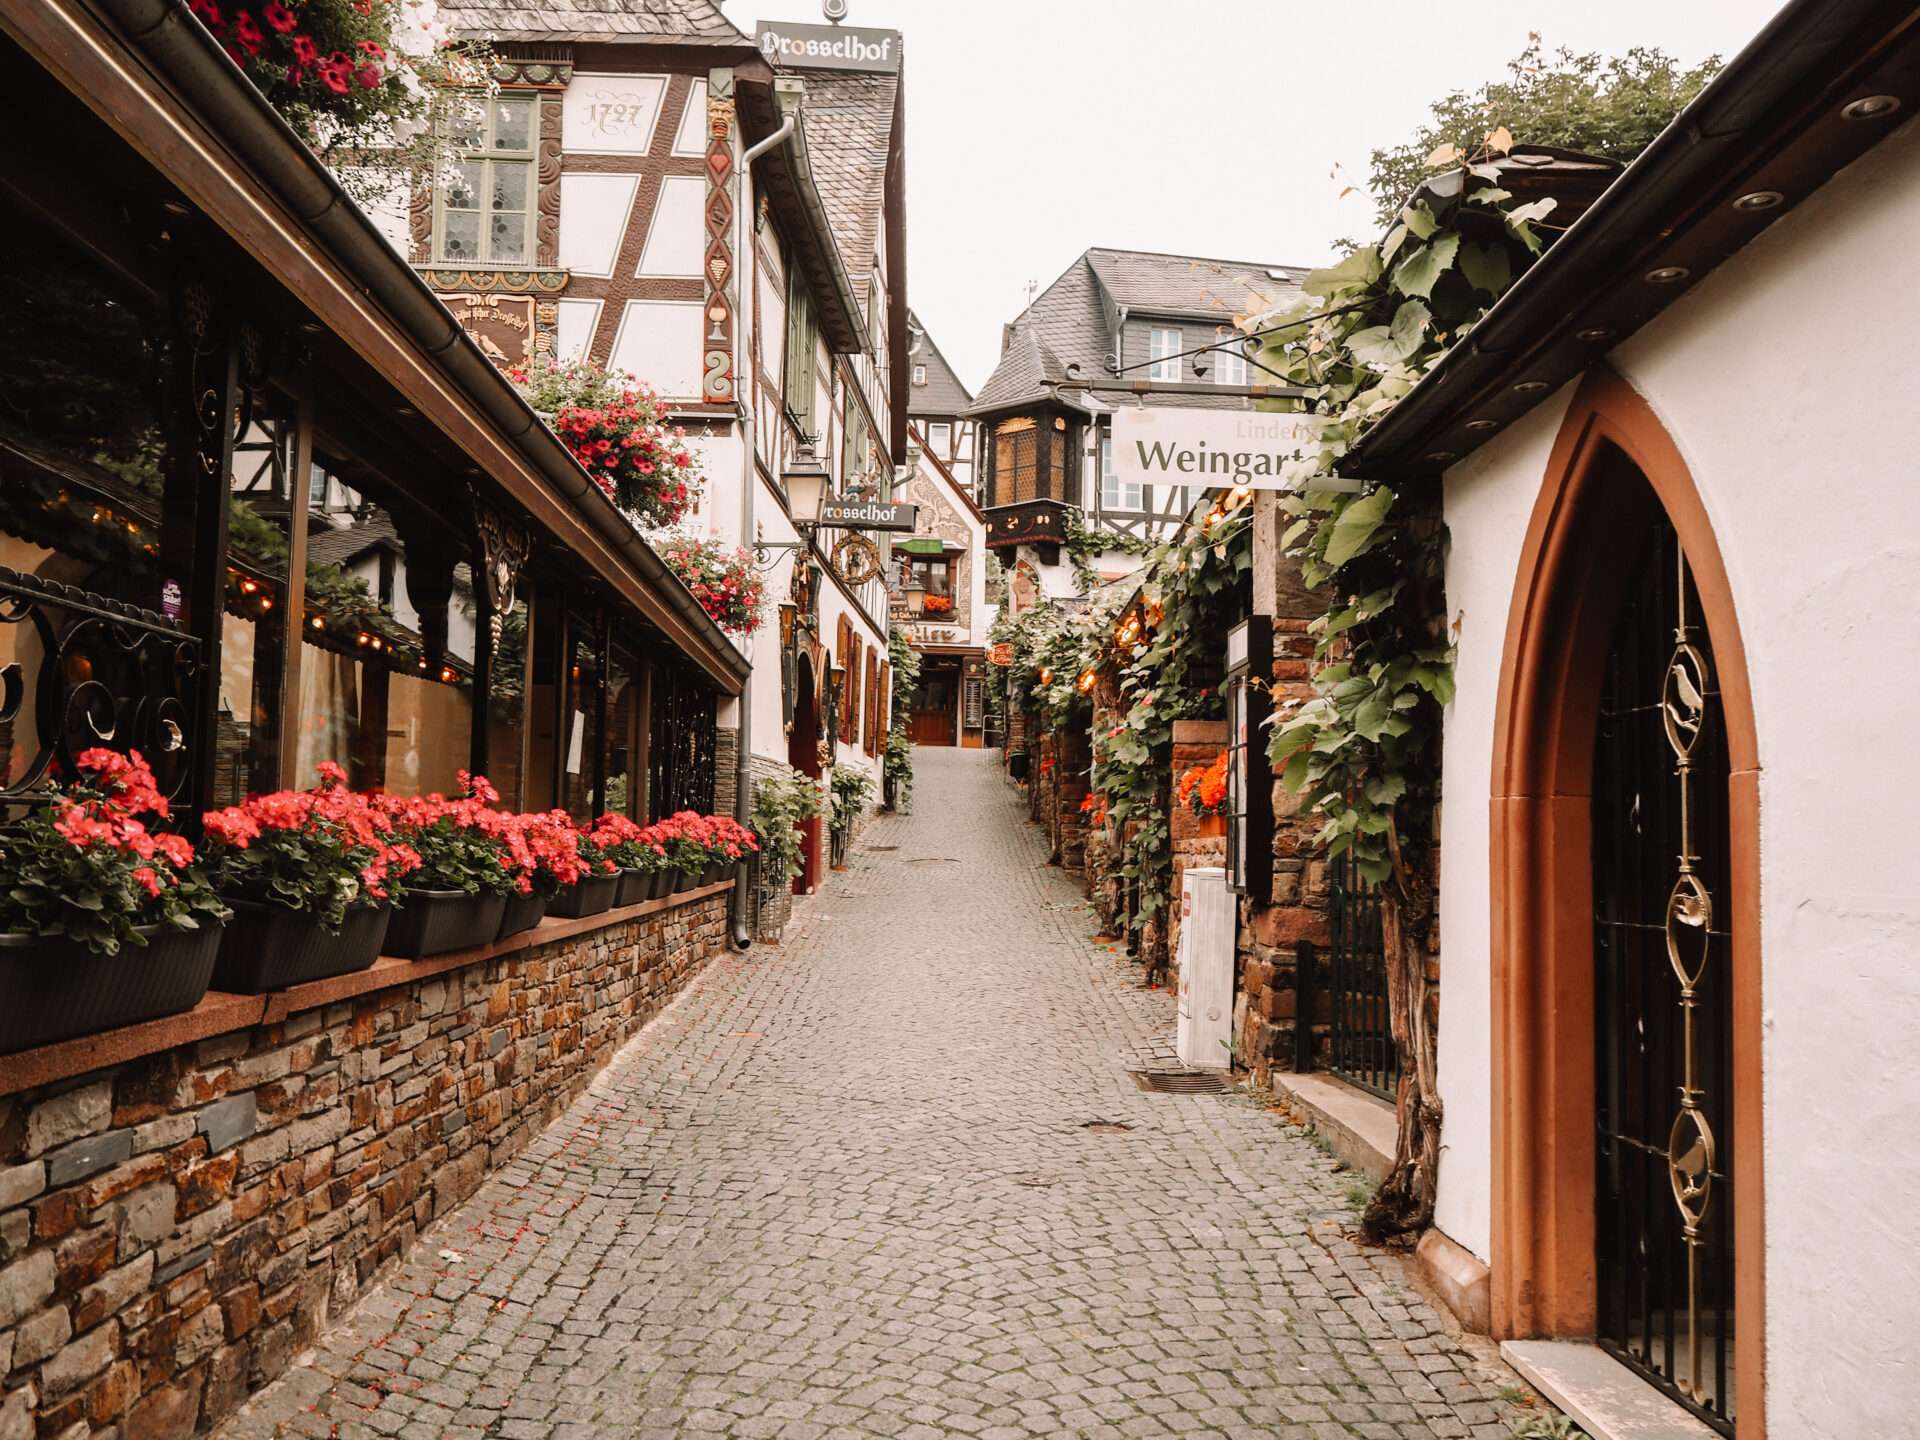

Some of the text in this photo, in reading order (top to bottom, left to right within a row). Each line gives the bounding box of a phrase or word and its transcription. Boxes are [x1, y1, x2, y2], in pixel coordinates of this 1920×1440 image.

[761, 31, 891, 62] Drosselhof
[1136, 440, 1318, 486] Weingart
[823, 504, 897, 522] rosselhof
